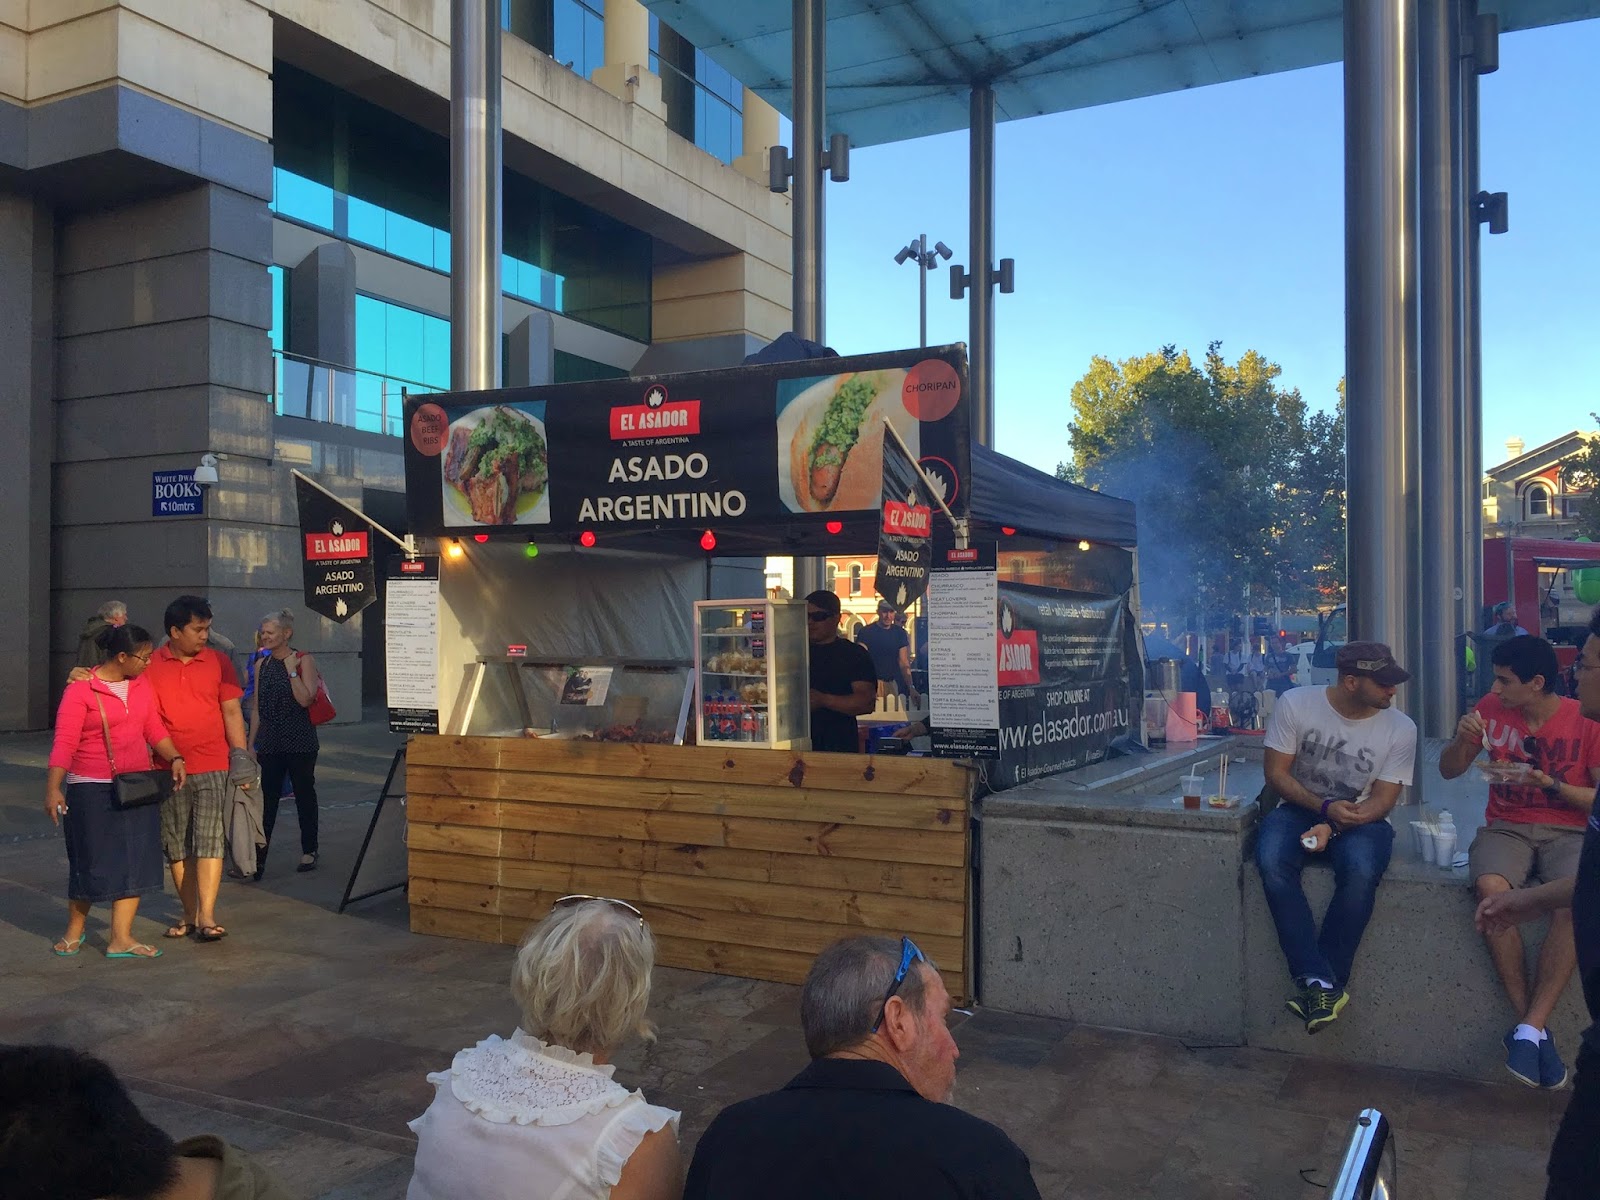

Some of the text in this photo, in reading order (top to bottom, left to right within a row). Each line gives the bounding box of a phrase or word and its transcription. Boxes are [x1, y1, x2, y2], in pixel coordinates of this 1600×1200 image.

[906, 381, 956, 393] CHORIPAN
[418, 414, 442, 422] ASADO
[620, 409, 688, 430] EL ASADOR
[422, 426, 438, 434] BEEF
[424, 436, 438, 445] RIBS
[655, 436, 690, 445] ARGENTINA
[608, 453, 708, 483] ASADO
[155, 482, 202, 499] BOOKS
[168, 502, 195, 512] 10mtrs
[578, 490, 746, 522] ARGENTINO
[890, 510, 926, 529] EL ASADOR
[315, 538, 360, 553] EL ASADOR
[894, 550, 919, 562] ASADO
[325, 570, 354, 582] ASADO
[885, 564, 924, 578] ARGENTINO
[316, 582, 364, 595] ARGENTINO
[999, 644, 1032, 671] ASADOR
[1003, 690, 1011, 699] OF
[1011, 688, 1035, 698] ARGENTINA
[1046, 691, 1062, 707] SHOP
[1084, 689, 1090, 702] AT
